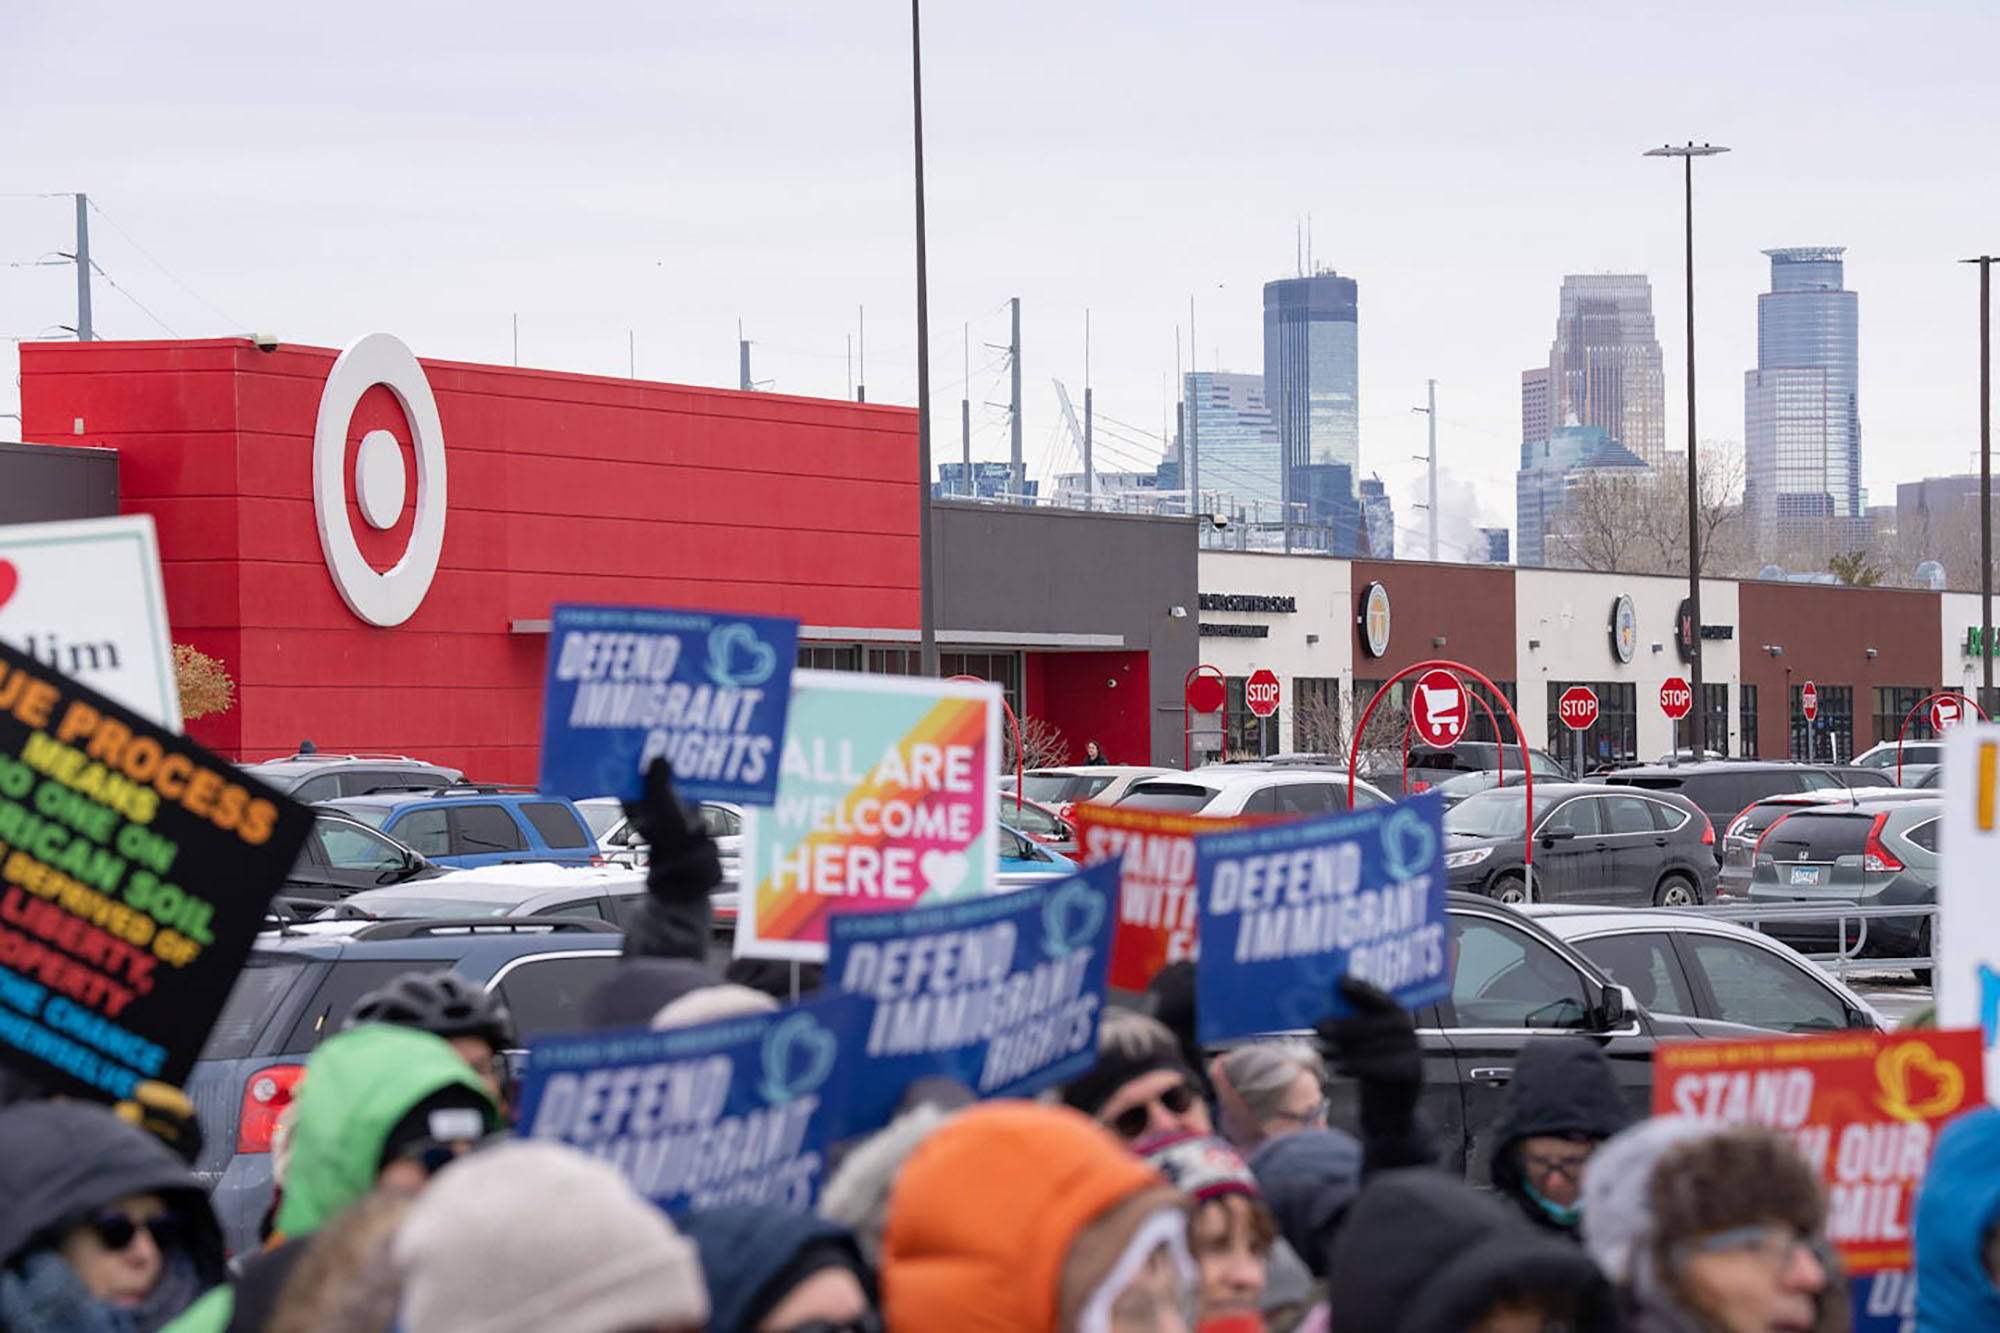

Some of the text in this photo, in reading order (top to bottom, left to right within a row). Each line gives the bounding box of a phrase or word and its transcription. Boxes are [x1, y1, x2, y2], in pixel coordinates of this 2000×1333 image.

[557, 631, 681, 680] DEFEND
[570, 682, 763, 733] IMMIGRANT
[1249, 683, 1279, 702] STOP
[1562, 700, 1596, 717] STOP
[1662, 690, 1690, 706] STOP
[23, 731, 160, 824] MEANS
[57, 701, 278, 845] PROCESS
[638, 729, 773, 784] RIGHTS
[781, 735, 974, 793] ALL ARE
[35, 780, 119, 844] ONE
[117, 823, 179, 874] ON
[775, 794, 973, 841] WELCOME
[771, 842, 916, 900] HERE
[1083, 825, 1196, 883] STAND
[1210, 841, 1361, 917] DEFEND
[123, 869, 215, 946] SOIL
[1235, 874, 1432, 964] IMMIGRANT
[153, 928, 200, 968] OF
[841, 920, 1019, 1000] DEFEND
[865, 946, 1094, 1058] IMMIGRANT
[529, 1053, 734, 1147] DEFEND
[1672, 1067, 1815, 1127] STAND
[1836, 1121, 1931, 1182] OUR
